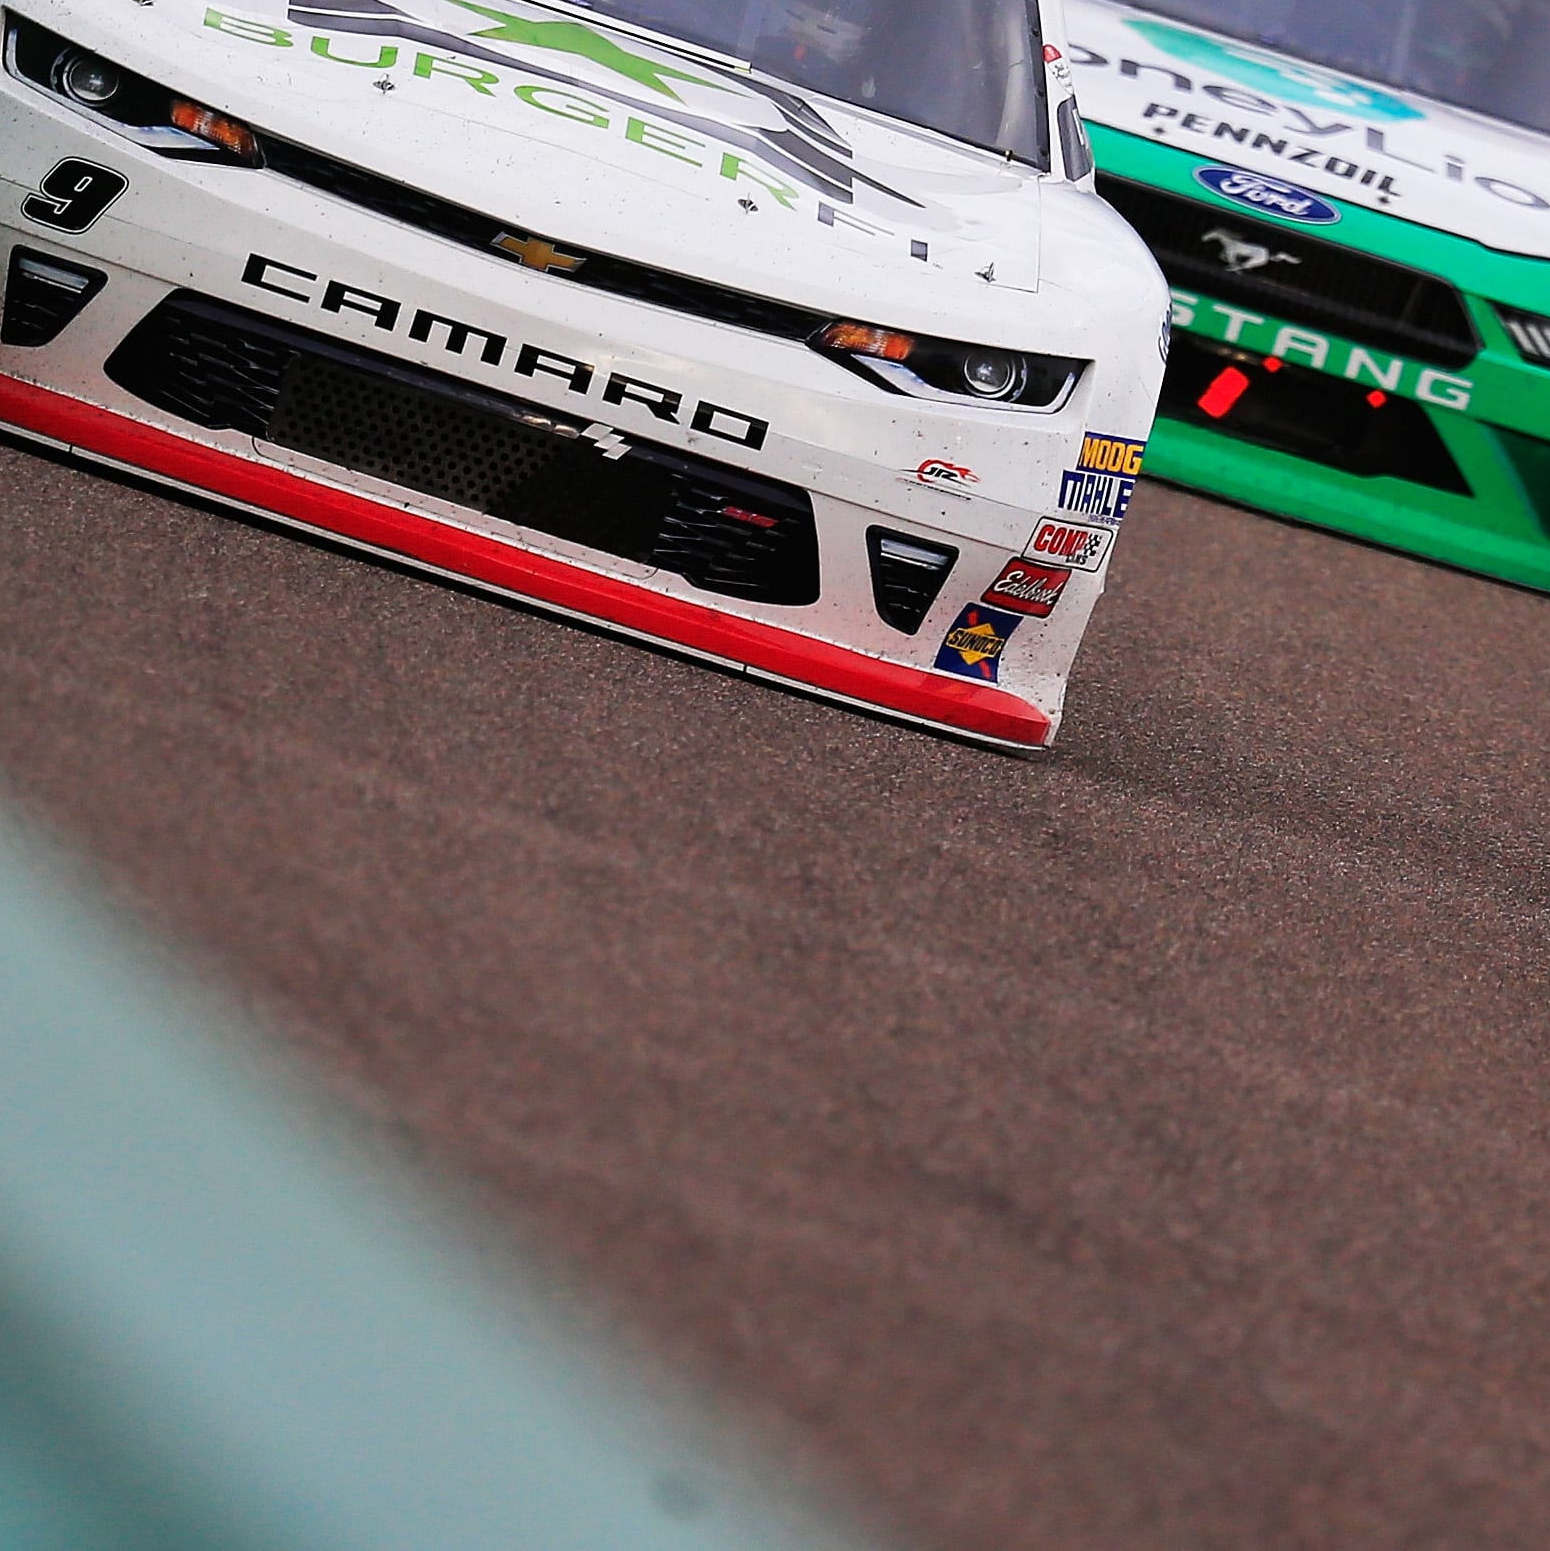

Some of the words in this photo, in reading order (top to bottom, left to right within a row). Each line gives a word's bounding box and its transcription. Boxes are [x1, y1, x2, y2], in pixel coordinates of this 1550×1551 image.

[1142, 102, 1401, 197] PENNZOIL
[20, 155, 130, 236] 9
[1218, 172, 1315, 217] Ford
[240, 252, 770, 451] CAMARO
[1079, 436, 1144, 476] MOOG
[1058, 470, 1134, 519] MAHLE
[1034, 524, 1088, 557] COMP
[949, 629, 1002, 656] SUNOCO
